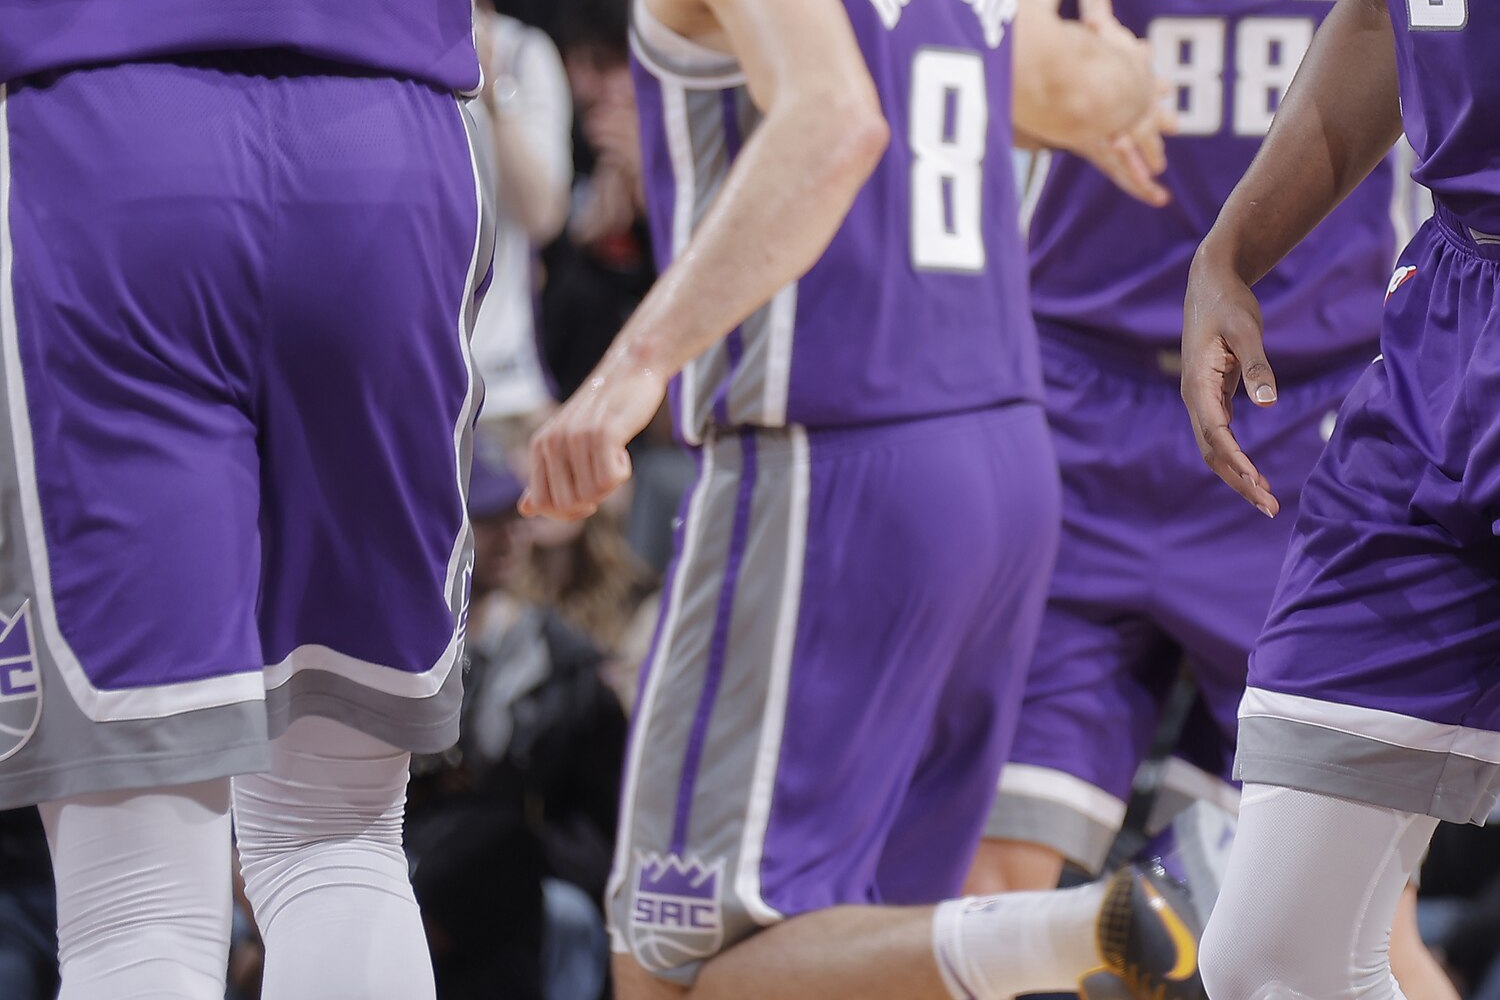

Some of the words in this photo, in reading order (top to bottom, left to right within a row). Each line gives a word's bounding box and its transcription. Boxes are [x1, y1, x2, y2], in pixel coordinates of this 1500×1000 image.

[1148, 15, 1316, 137] 88
[909, 46, 988, 275] 8
[635, 898, 717, 929] SAC
